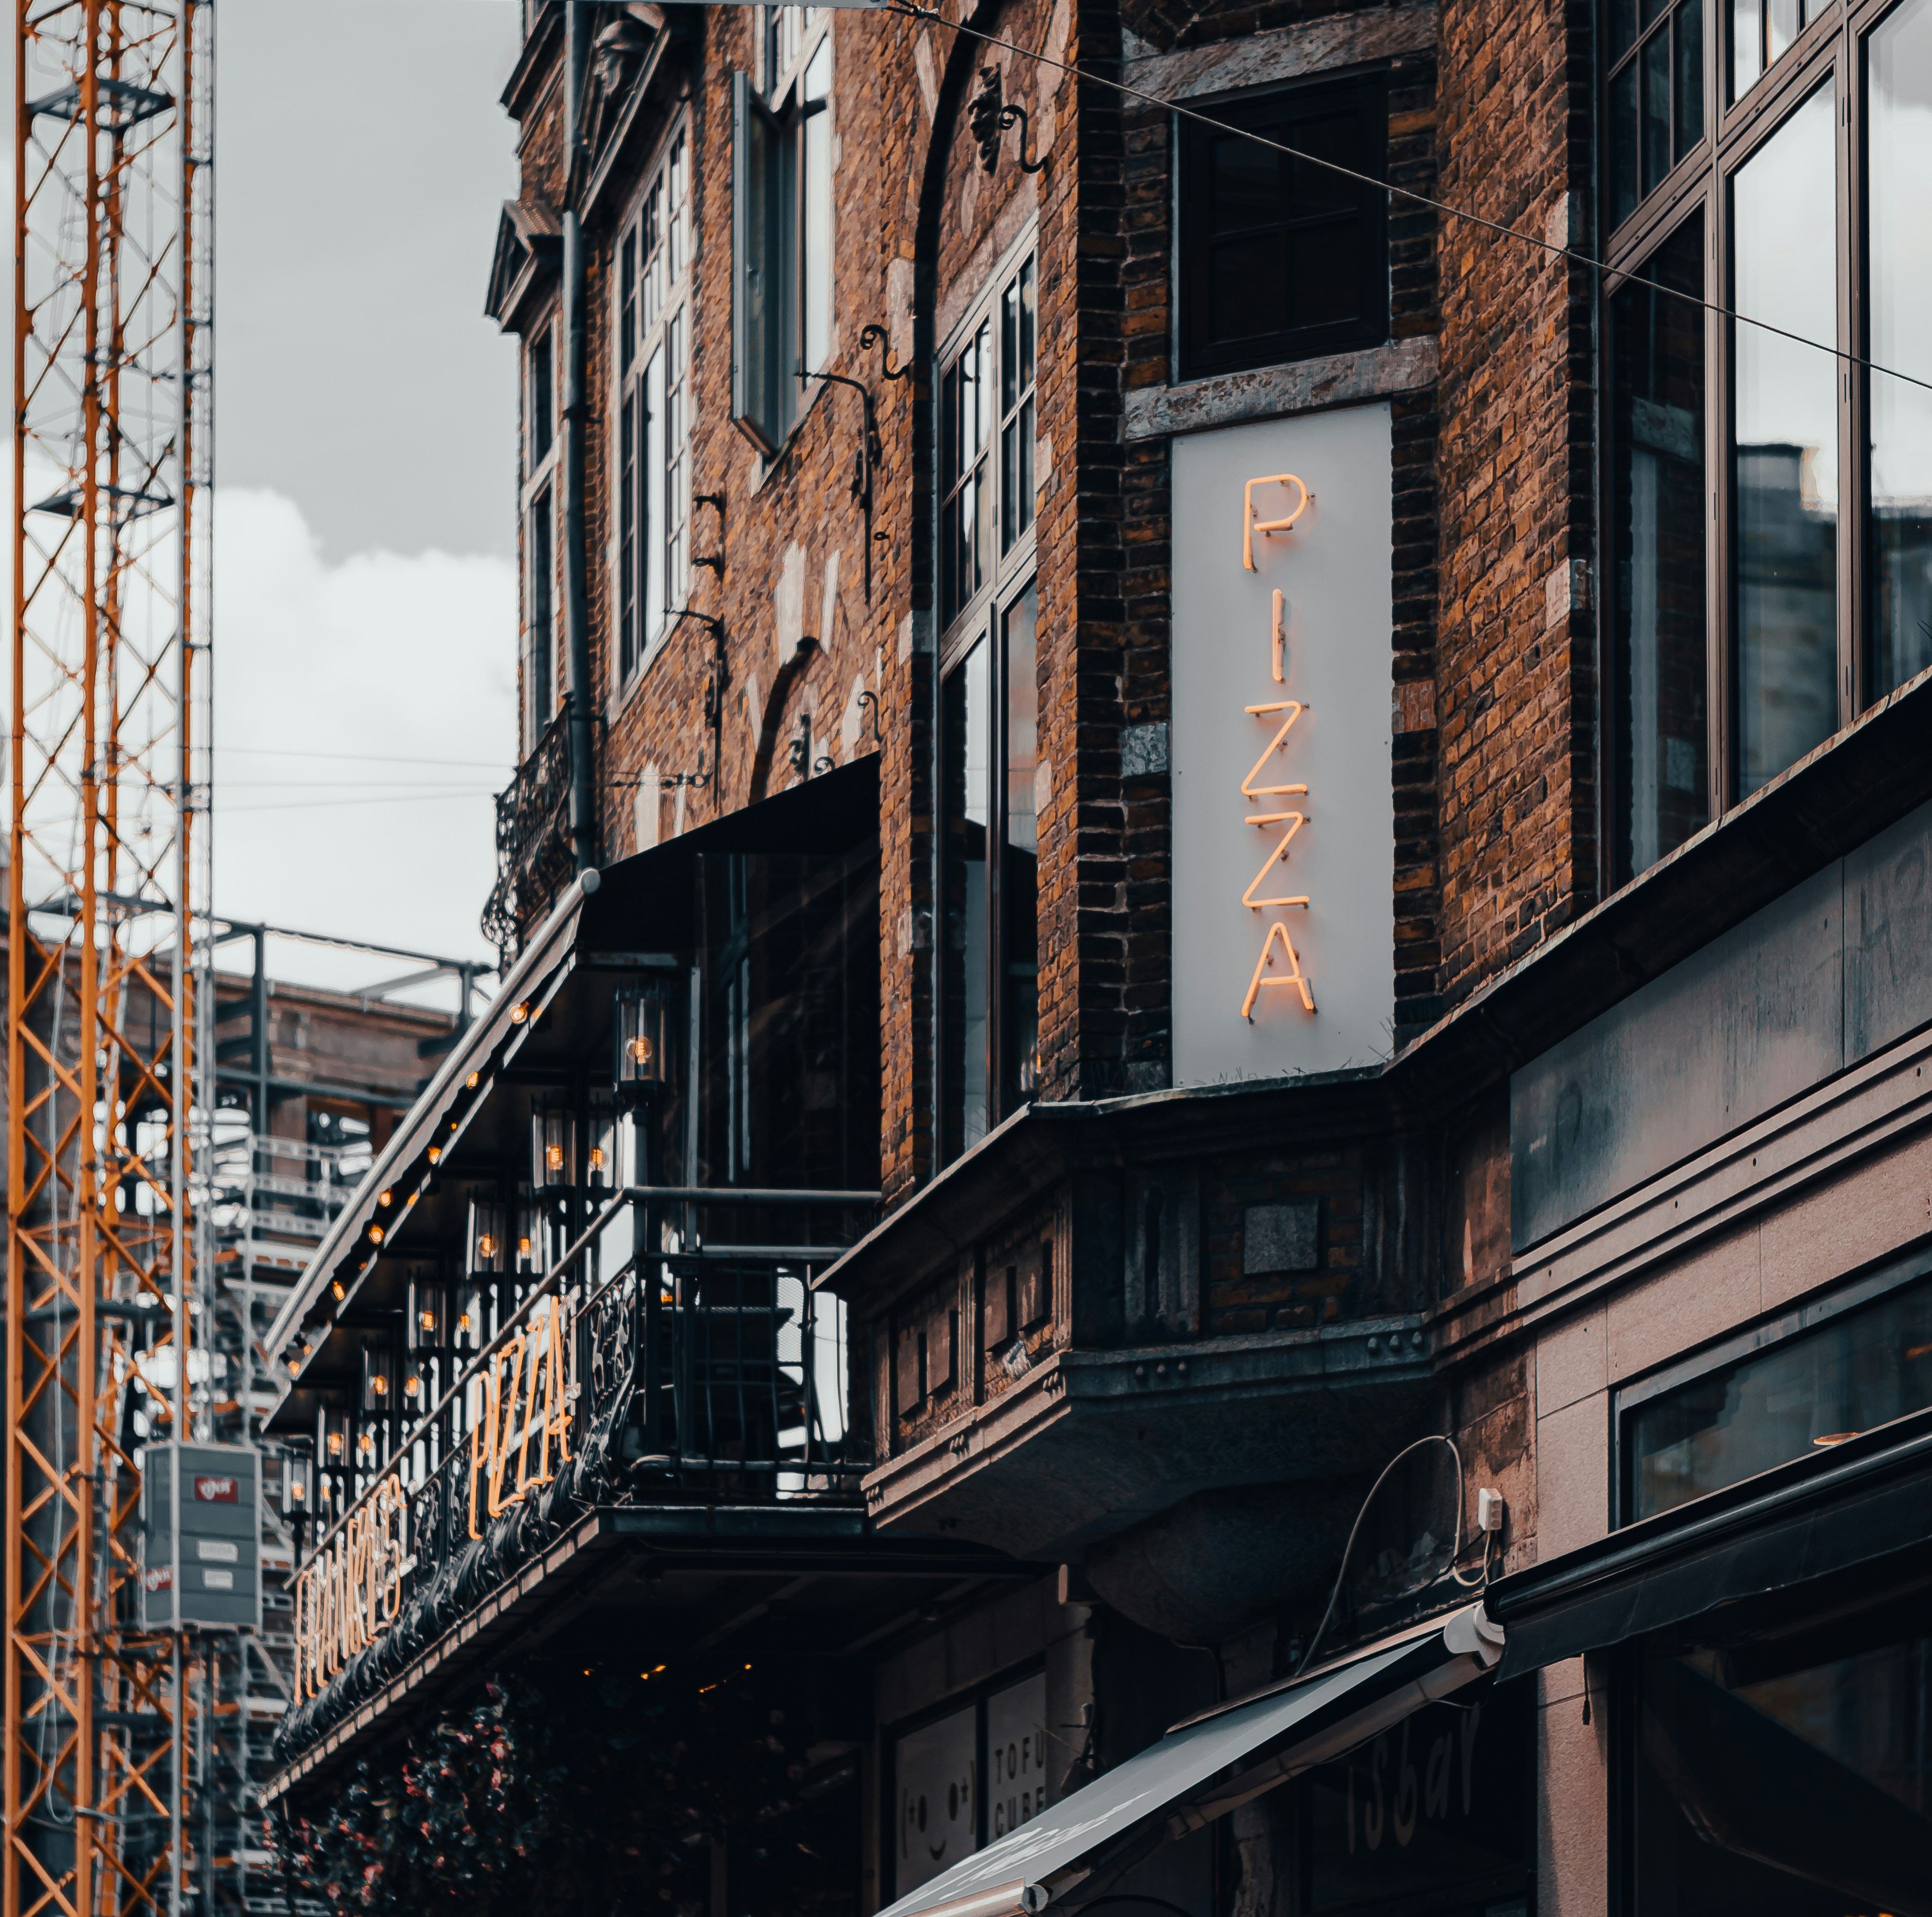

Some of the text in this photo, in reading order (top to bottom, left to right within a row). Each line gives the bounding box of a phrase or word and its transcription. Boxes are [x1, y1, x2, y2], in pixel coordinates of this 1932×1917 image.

[1241, 473, 1315, 1021] PIZZA
[468, 1295, 573, 1540] PIZZA
[995, 1730, 1046, 1784] TOFU
